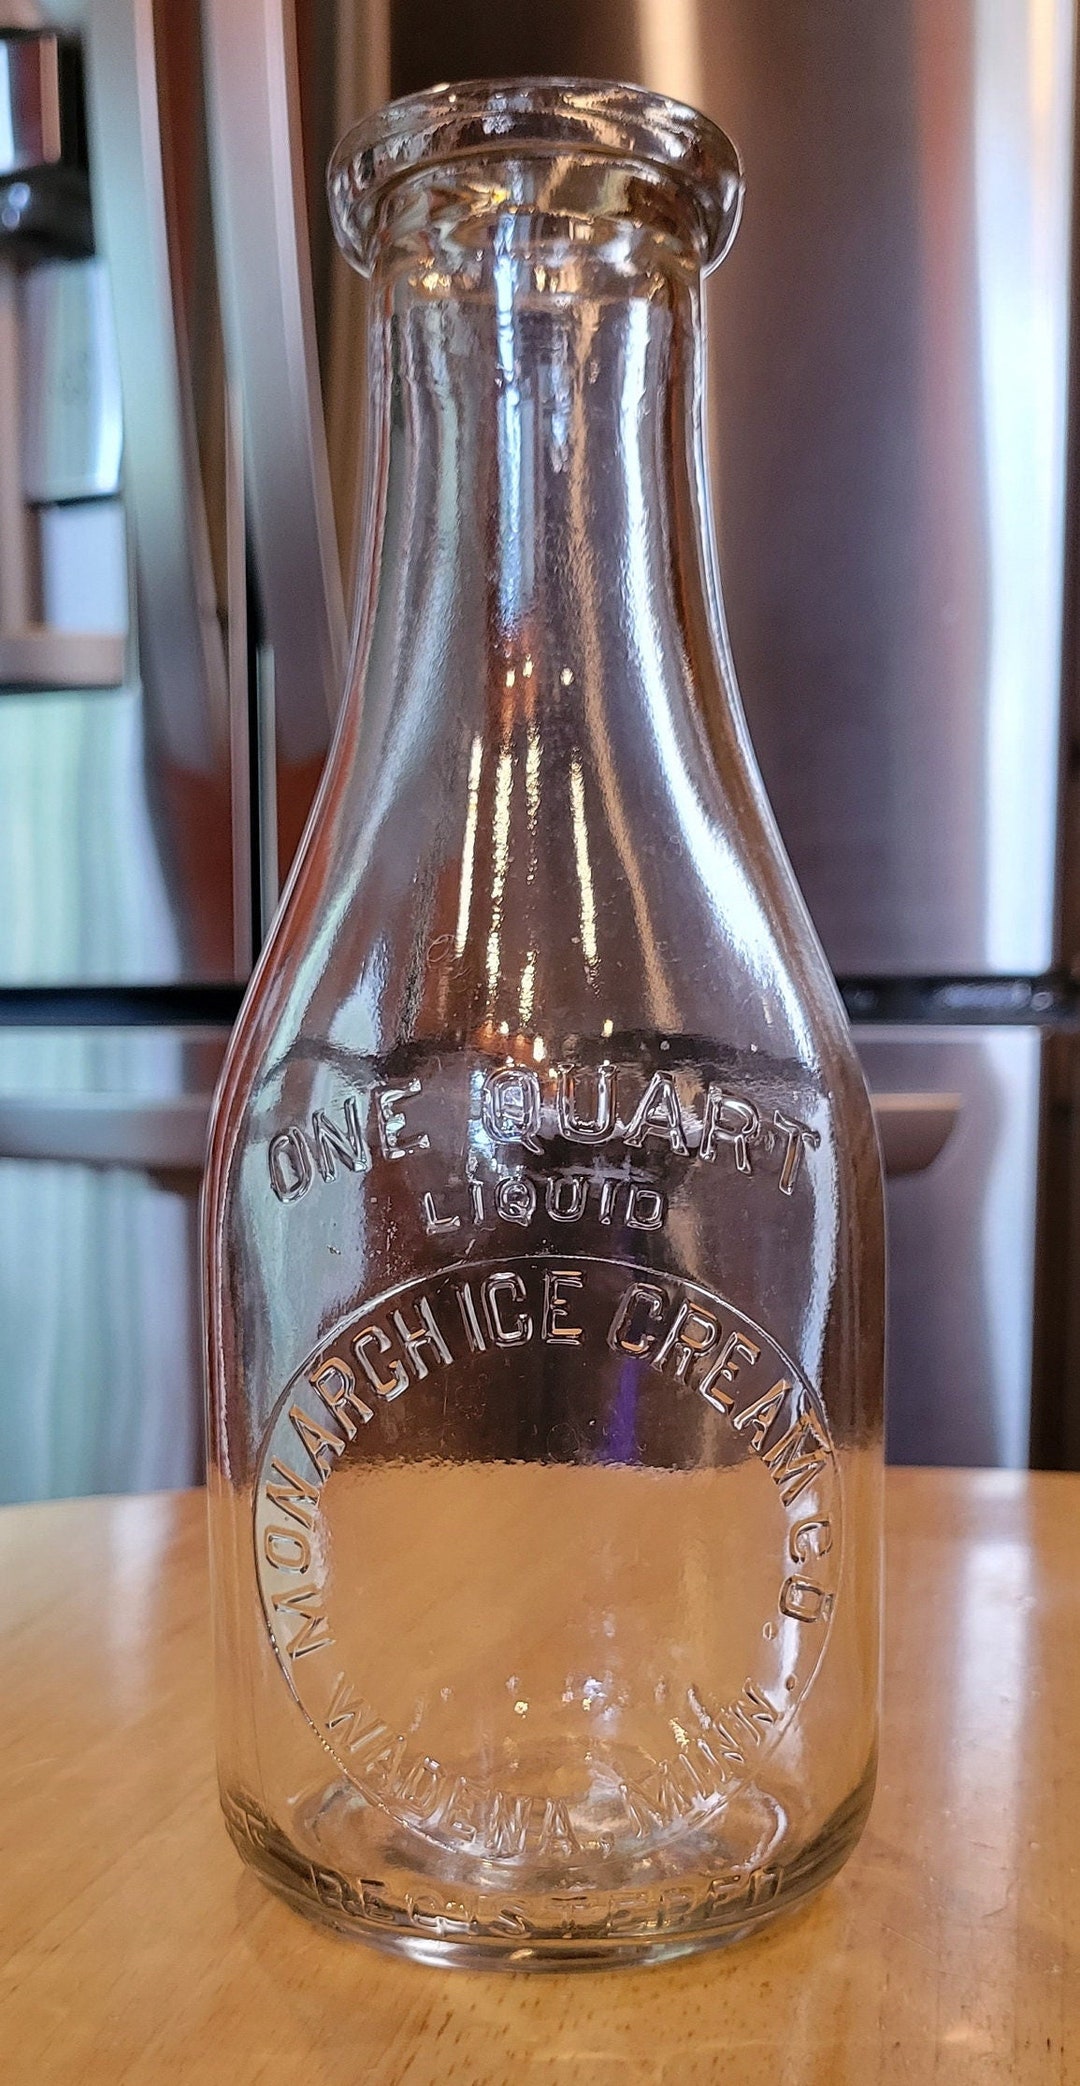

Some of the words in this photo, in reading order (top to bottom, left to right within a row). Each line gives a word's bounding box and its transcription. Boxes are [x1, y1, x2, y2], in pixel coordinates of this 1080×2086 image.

[266, 1077, 430, 1204] ONE
[477, 1062, 822, 1196] QUART
[423, 1174, 667, 1234] LIQUID
[263, 1294, 456, 1660] MONARCH
[455, 1270, 584, 1352] ICE
[607, 1281, 833, 1508] CREAM
[303, 1860, 785, 1939] REGISTERED
